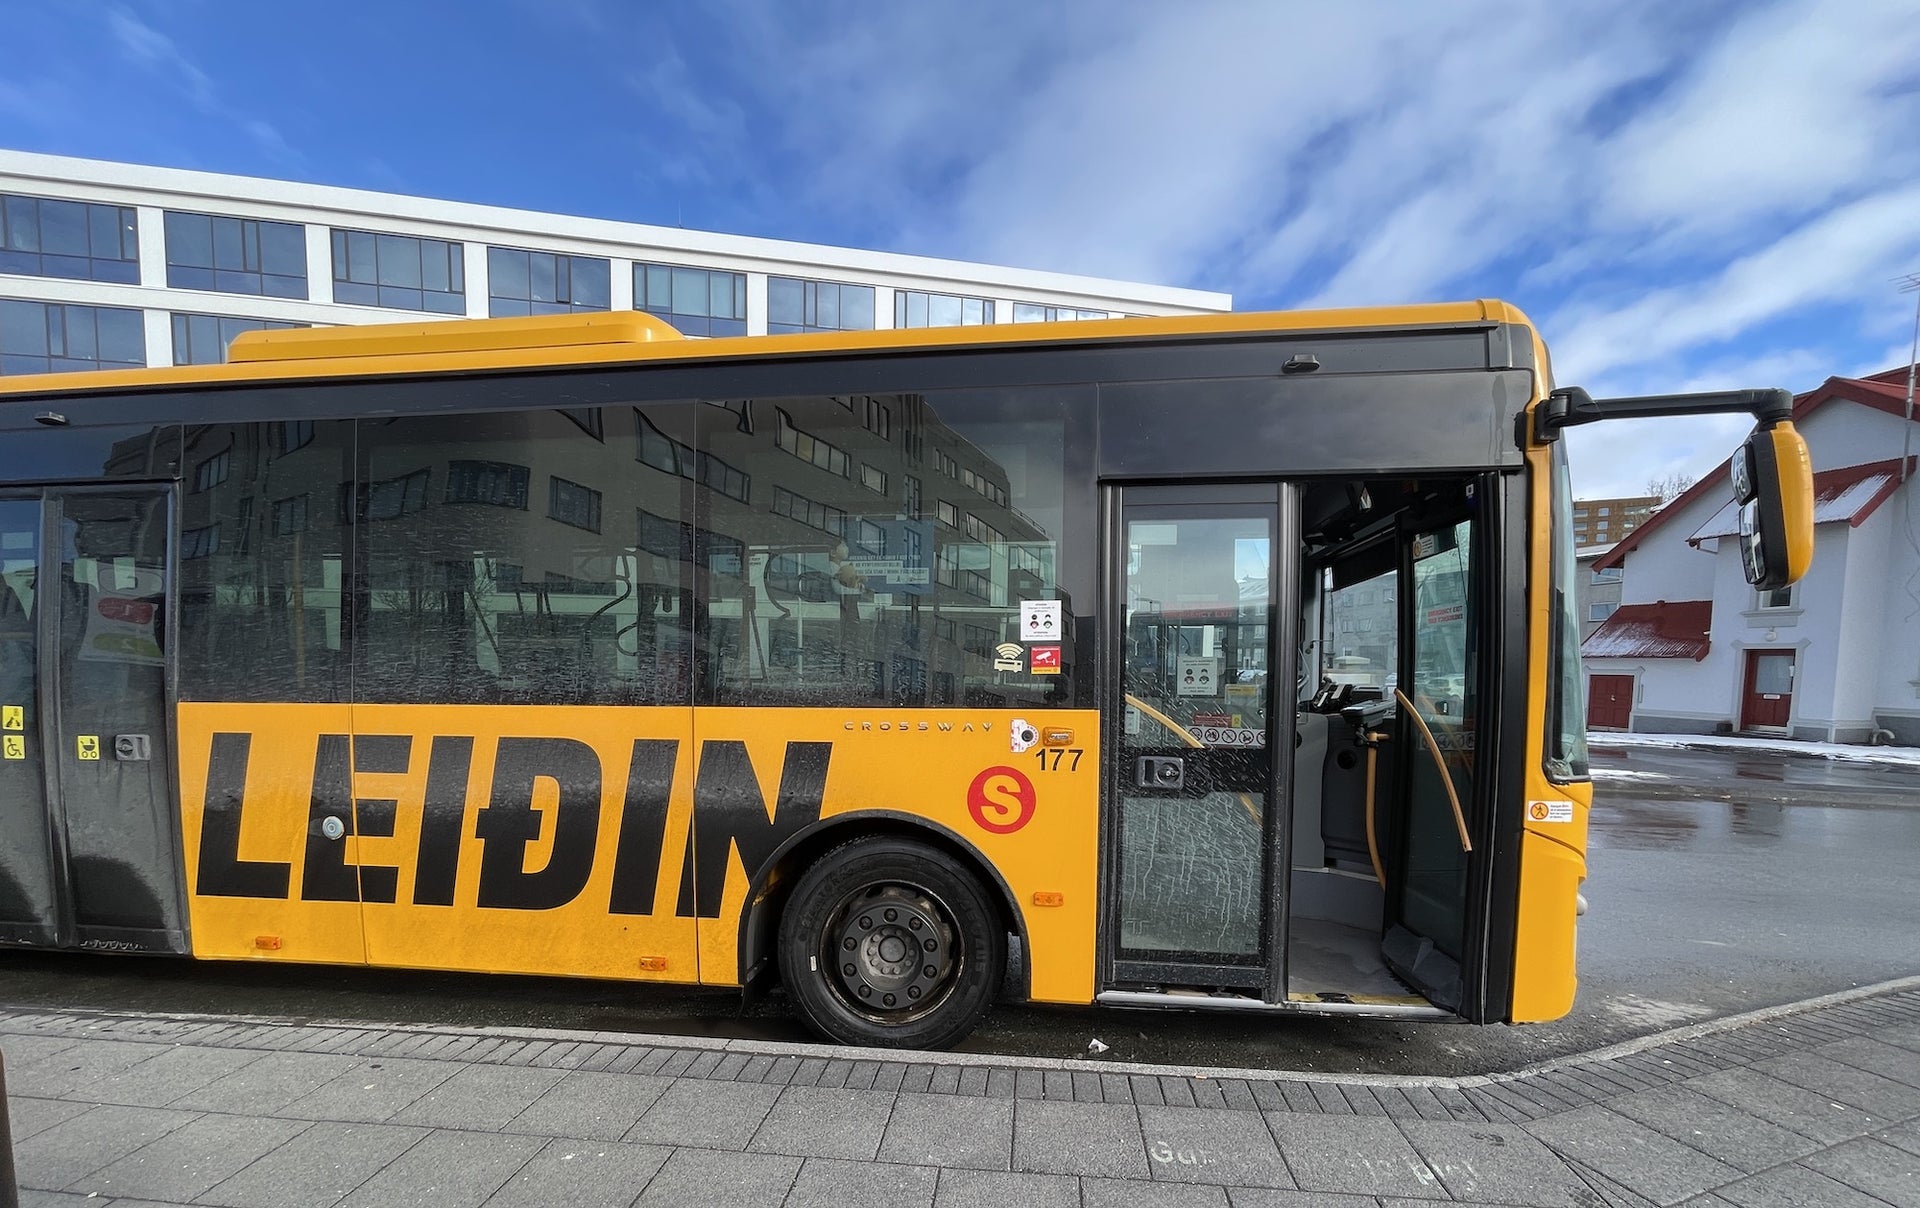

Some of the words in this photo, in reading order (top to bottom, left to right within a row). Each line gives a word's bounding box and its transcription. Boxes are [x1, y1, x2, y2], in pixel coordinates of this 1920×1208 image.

[844, 721, 993, 732] CROSSWAY
[1035, 748, 1083, 771] 177
[195, 732, 833, 918] LEIÐIN
